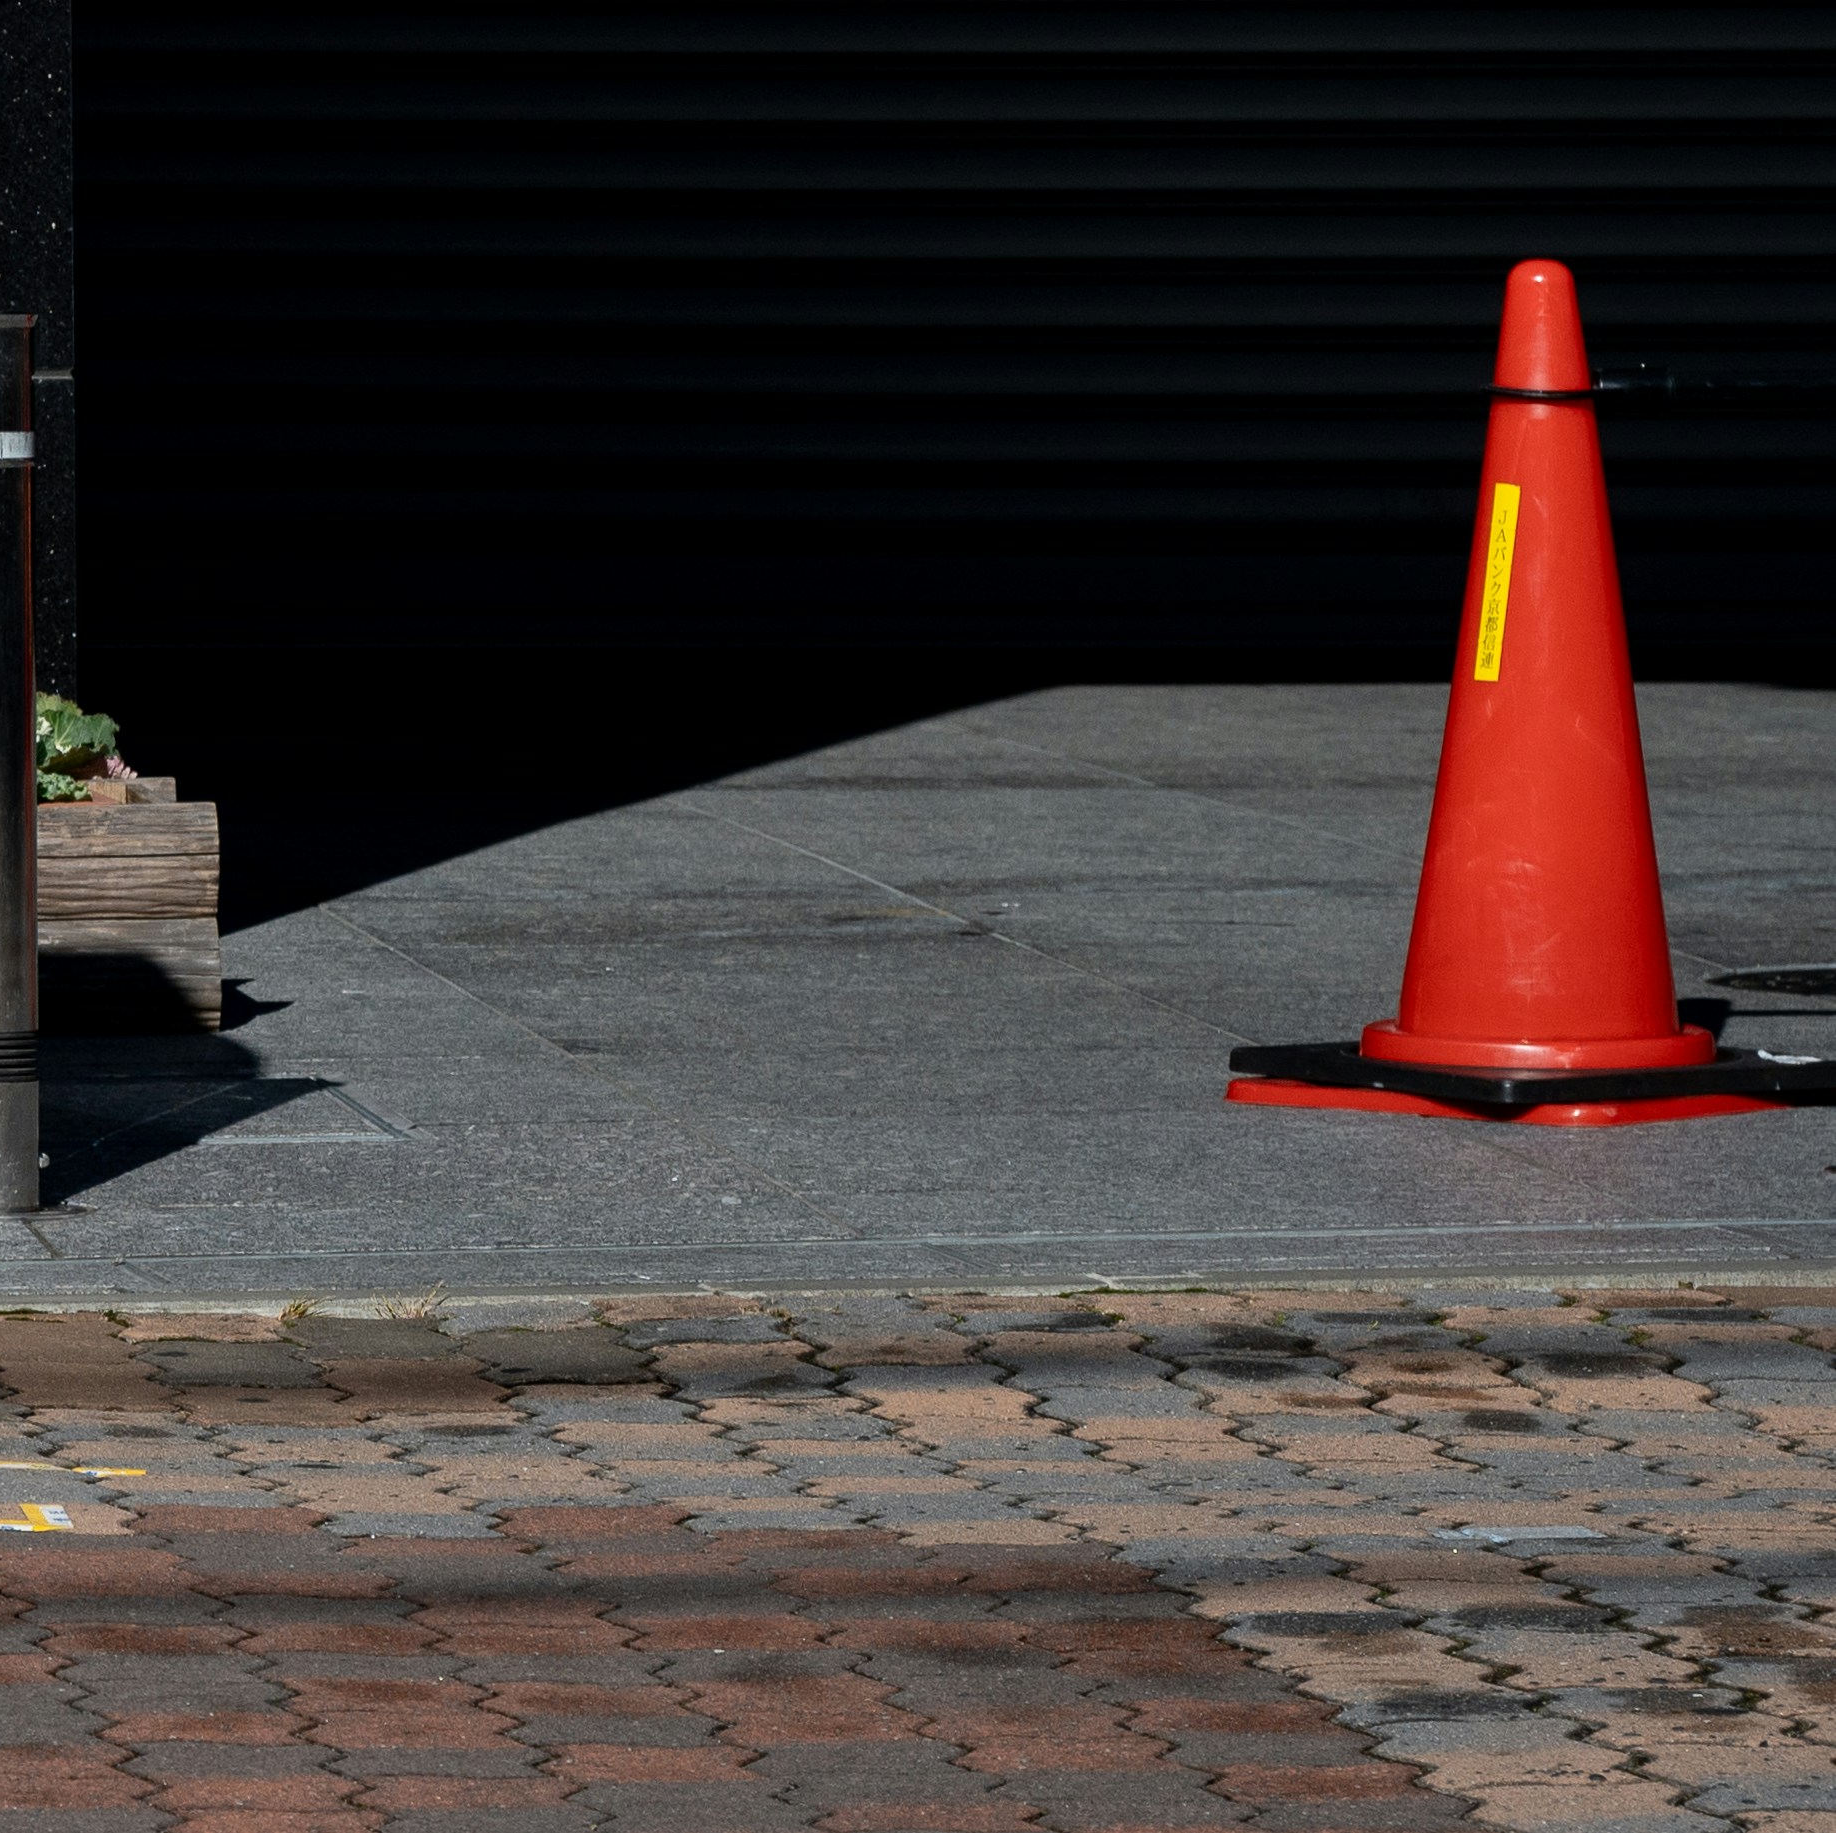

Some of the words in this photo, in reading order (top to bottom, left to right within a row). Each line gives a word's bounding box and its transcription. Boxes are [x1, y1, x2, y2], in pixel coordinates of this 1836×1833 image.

[1480, 510, 1508, 669] JAバンク京都信連
